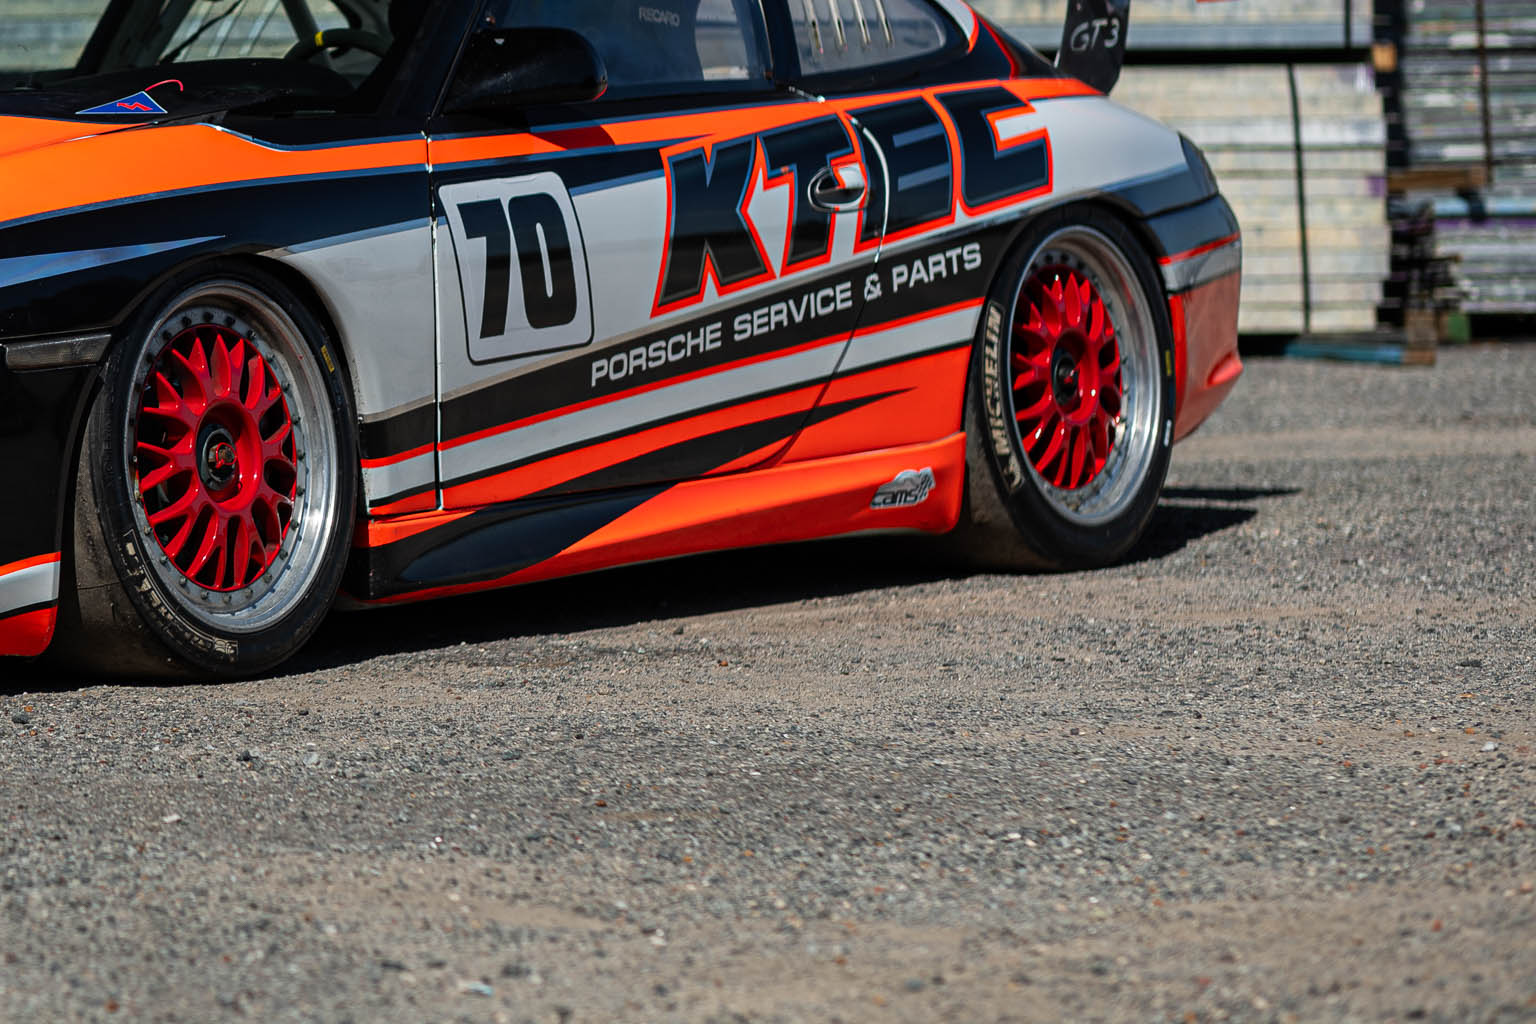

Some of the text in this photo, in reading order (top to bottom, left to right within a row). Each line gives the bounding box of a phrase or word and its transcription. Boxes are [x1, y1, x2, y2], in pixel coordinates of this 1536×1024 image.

[638, 7, 681, 27] RECARO
[1070, 18, 1120, 52] GT3
[456, 192, 578, 339] 70
[650, 82, 1054, 319] KTEC
[591, 242, 983, 388] PORSCHE SERVICE & PARTS
[983, 305, 1011, 456] MICHELIN
